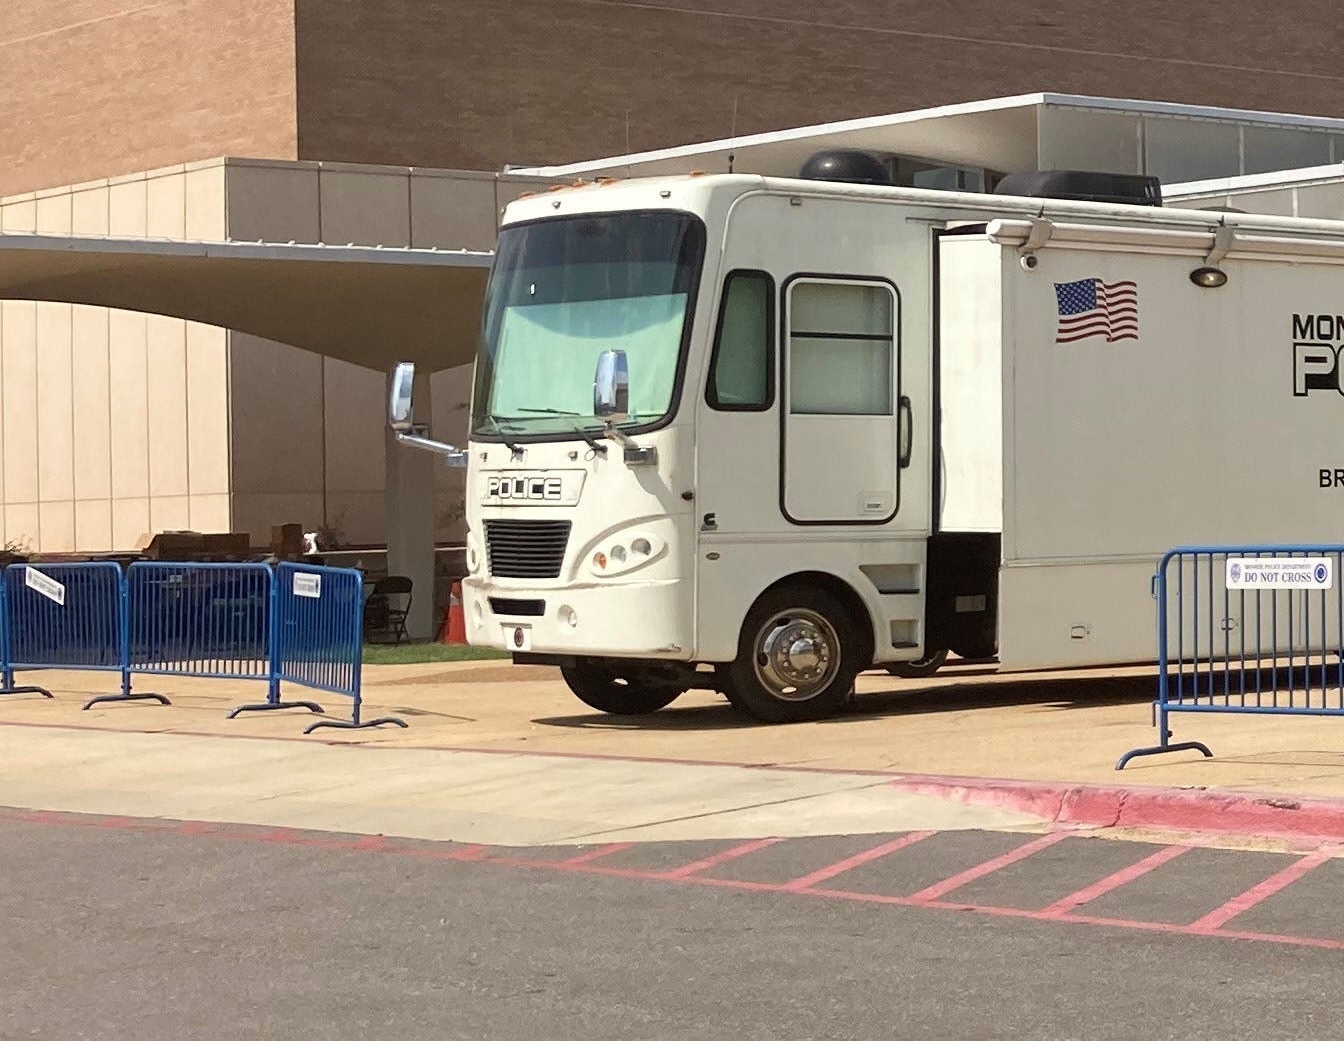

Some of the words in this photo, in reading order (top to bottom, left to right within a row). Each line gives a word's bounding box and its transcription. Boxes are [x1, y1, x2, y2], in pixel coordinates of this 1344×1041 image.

[487, 476, 561, 500] POLICE
[1244, 572, 1258, 583] DO
[1260, 572, 1279, 583] NOT
[1281, 572, 1312, 583] CROSS
